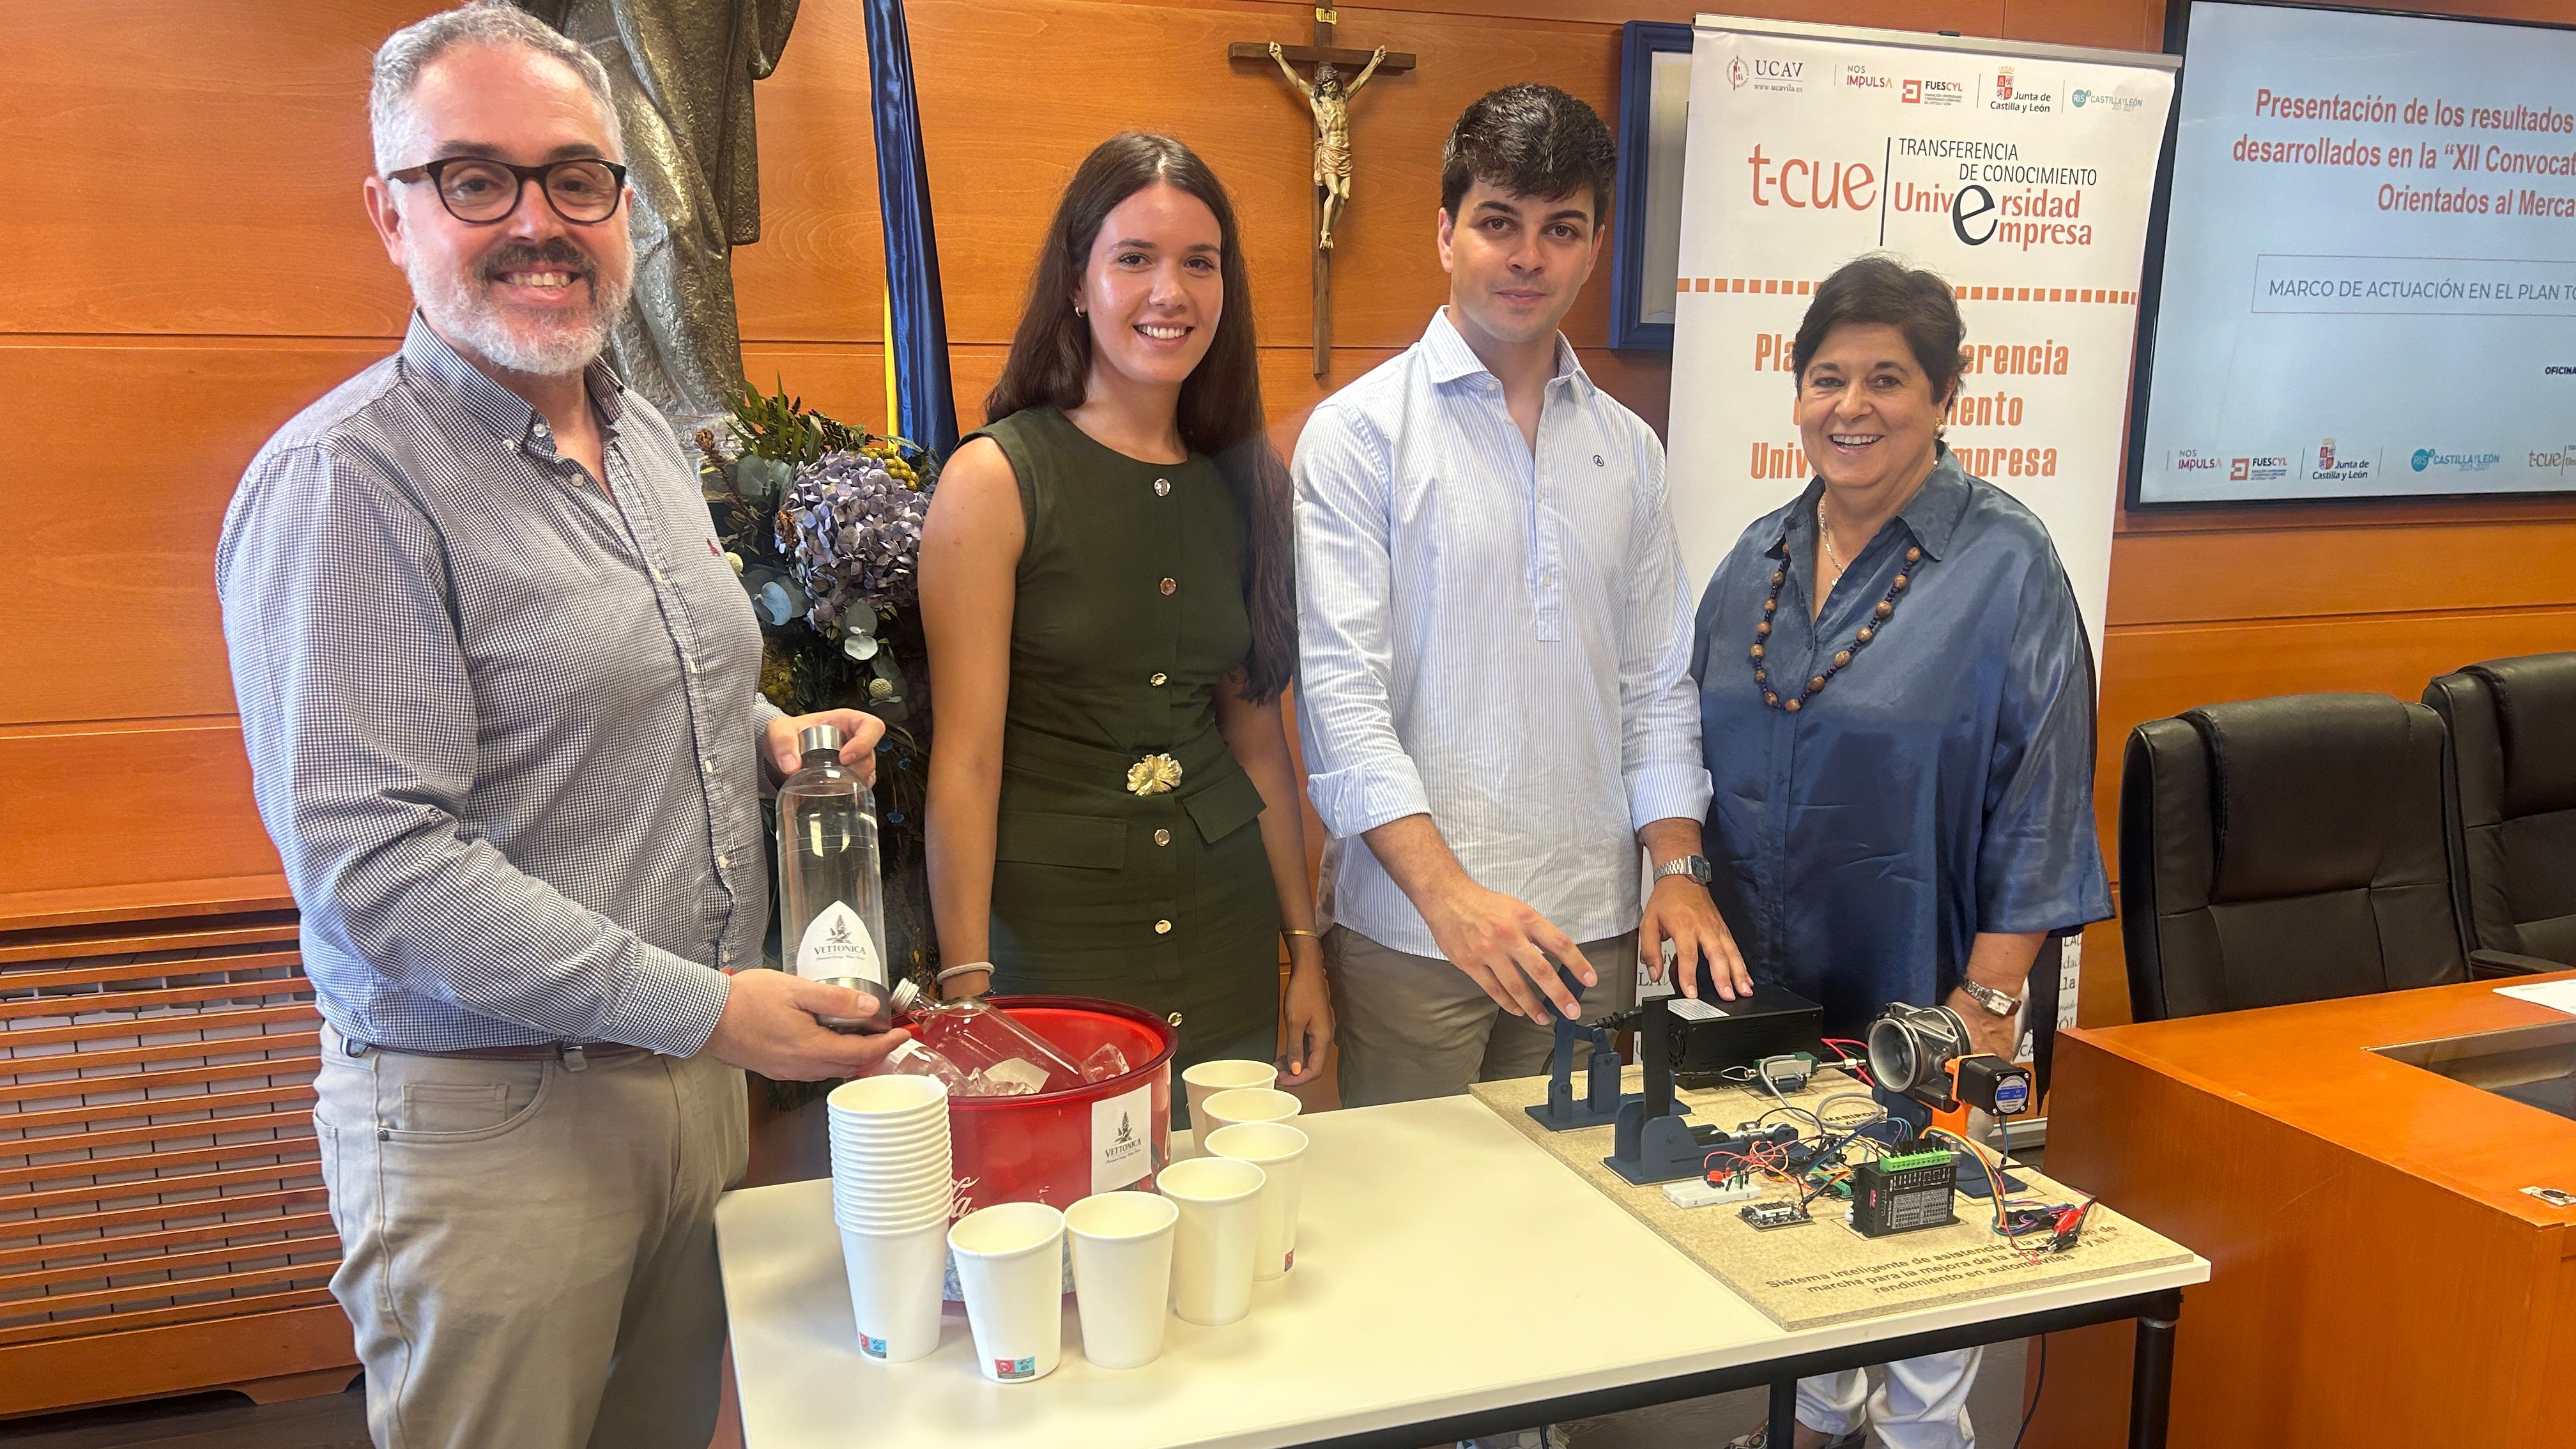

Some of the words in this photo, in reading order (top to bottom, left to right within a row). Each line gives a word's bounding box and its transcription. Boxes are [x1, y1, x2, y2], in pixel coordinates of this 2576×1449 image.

[1755, 59, 1804, 77] UCAV
[1847, 65, 1866, 73] NOS
[1754, 83, 1803, 93] www.ucavila.es
[1847, 75, 1892, 88] IMPULSA
[1925, 81, 1963, 92] FUESCYL
[2014, 91, 2038, 102] Junta
[2041, 92, 2051, 102] de
[1990, 101, 2020, 111] Castilla
[2021, 104, 2027, 113] y
[2030, 103, 2050, 112] León
[2255, 88, 2397, 124] Presentación
[2404, 98, 2428, 126] de
[2434, 99, 2465, 127] los
[2471, 103, 2574, 134] resultados
[1899, 137, 2019, 161] TRANSFERENCIA
[2233, 134, 2380, 167] desarrollados
[2388, 145, 2412, 168] en
[2419, 141, 2437, 170] la
[1959, 162, 1979, 181] DE
[1983, 164, 2097, 186] CONOCIMIENTO
[2378, 183, 2489, 215] Orientados
[2496, 189, 2513, 215] al
[2518, 189, 2576, 218] Merca
[2269, 280, 2334, 298] MARCO
[2339, 280, 2362, 298] DE
[2366, 279, 2464, 299] ACTUACIÓN
[2469, 282, 2490, 300] EN
[2496, 283, 2514, 300] EL
[2518, 284, 2559, 300] PLAN
[1755, 334, 1794, 372] Pla
[1961, 339, 2069, 375] erencia
[1952, 447, 2057, 479] mpresa
[2253, 457, 2287, 466] FUESCYL
[2334, 459, 2358, 470] Junta
[2359, 459, 2370, 468] de
[2312, 470, 2340, 480] Castilla
[2348, 470, 2368, 479] León
[814, 945, 866, 954] VETTONICA
[1105, 1138, 1142, 1158] VETTONICA
[1766, 1273, 1828, 1288] Sistema
[1830, 1260, 1909, 1278] inteligente
[1912, 1255, 1931, 1265] de
[1933, 1245, 2009, 1261] asistencia
[2019, 1238, 2034, 1246] la
[1806, 1278, 1865, 1293] marcha
[1866, 1272, 1903, 1285] para
[1905, 1268, 1917, 1277] la
[1920, 1259, 1971, 1276] mejora
[1973, 1256, 1992, 1265] de
[1993, 1252, 2008, 1261] la
[1873, 1273, 1963, 1294] rendimiento
[1966, 1269, 1985, 1278] en
